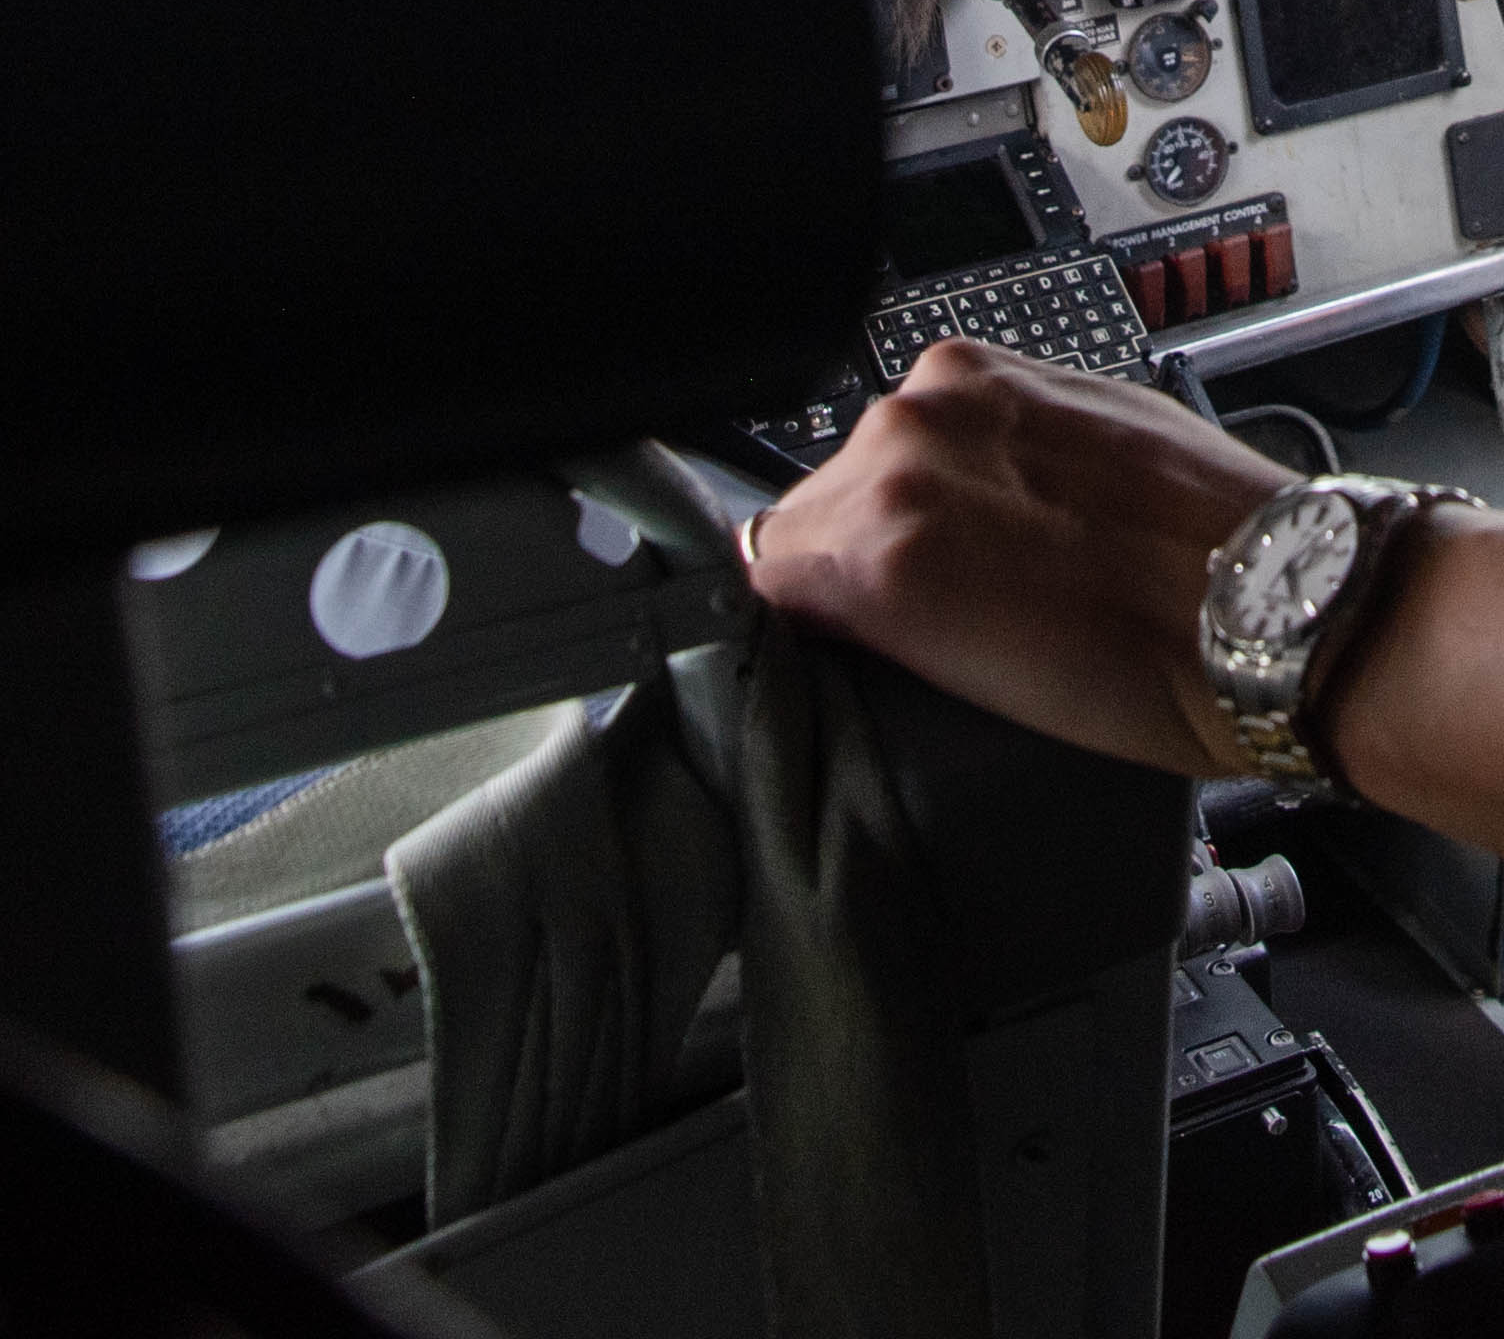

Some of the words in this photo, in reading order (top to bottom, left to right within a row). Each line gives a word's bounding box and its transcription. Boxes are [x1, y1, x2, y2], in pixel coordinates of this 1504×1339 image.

[1113, 232, 1148, 248] POWER
[1150, 214, 1221, 239] MANAGEMENT
[1223, 202, 1269, 222] CONTROL
[1094, 264, 1103, 274] F
[1040, 277, 1051, 289] D
[1013, 284, 1025, 295] C
[1103, 284, 1115, 296] L
[986, 291, 997, 302] B
[1077, 291, 1088, 302] K
[959, 298, 971, 310] A
[1051, 298, 1061, 309] J
[931, 305, 942, 316] 3
[1113, 304, 1125, 315] R
[902, 312, 913, 324] 2
[994, 311, 1007, 323] H
[1086, 311, 1099, 322] Q
[967, 318, 979, 330] G
[1059, 317, 1069, 329] P
[939, 325, 951, 336] 6
[1031, 324, 1043, 336] O
[1122, 324, 1134, 334] X
[912, 332, 924, 343] 5
[1068, 337, 1079, 348] V
[884, 339, 894, 351] 4
[1040, 344, 1052, 355] U
[1118, 347, 1130, 358] Z
[892, 359, 902, 371] 7
[1092, 355, 1103, 365] Y
[1263, 876, 1274, 891] 4
[1203, 892, 1215, 907] 3
[1368, 1188, 1383, 1202] 20
